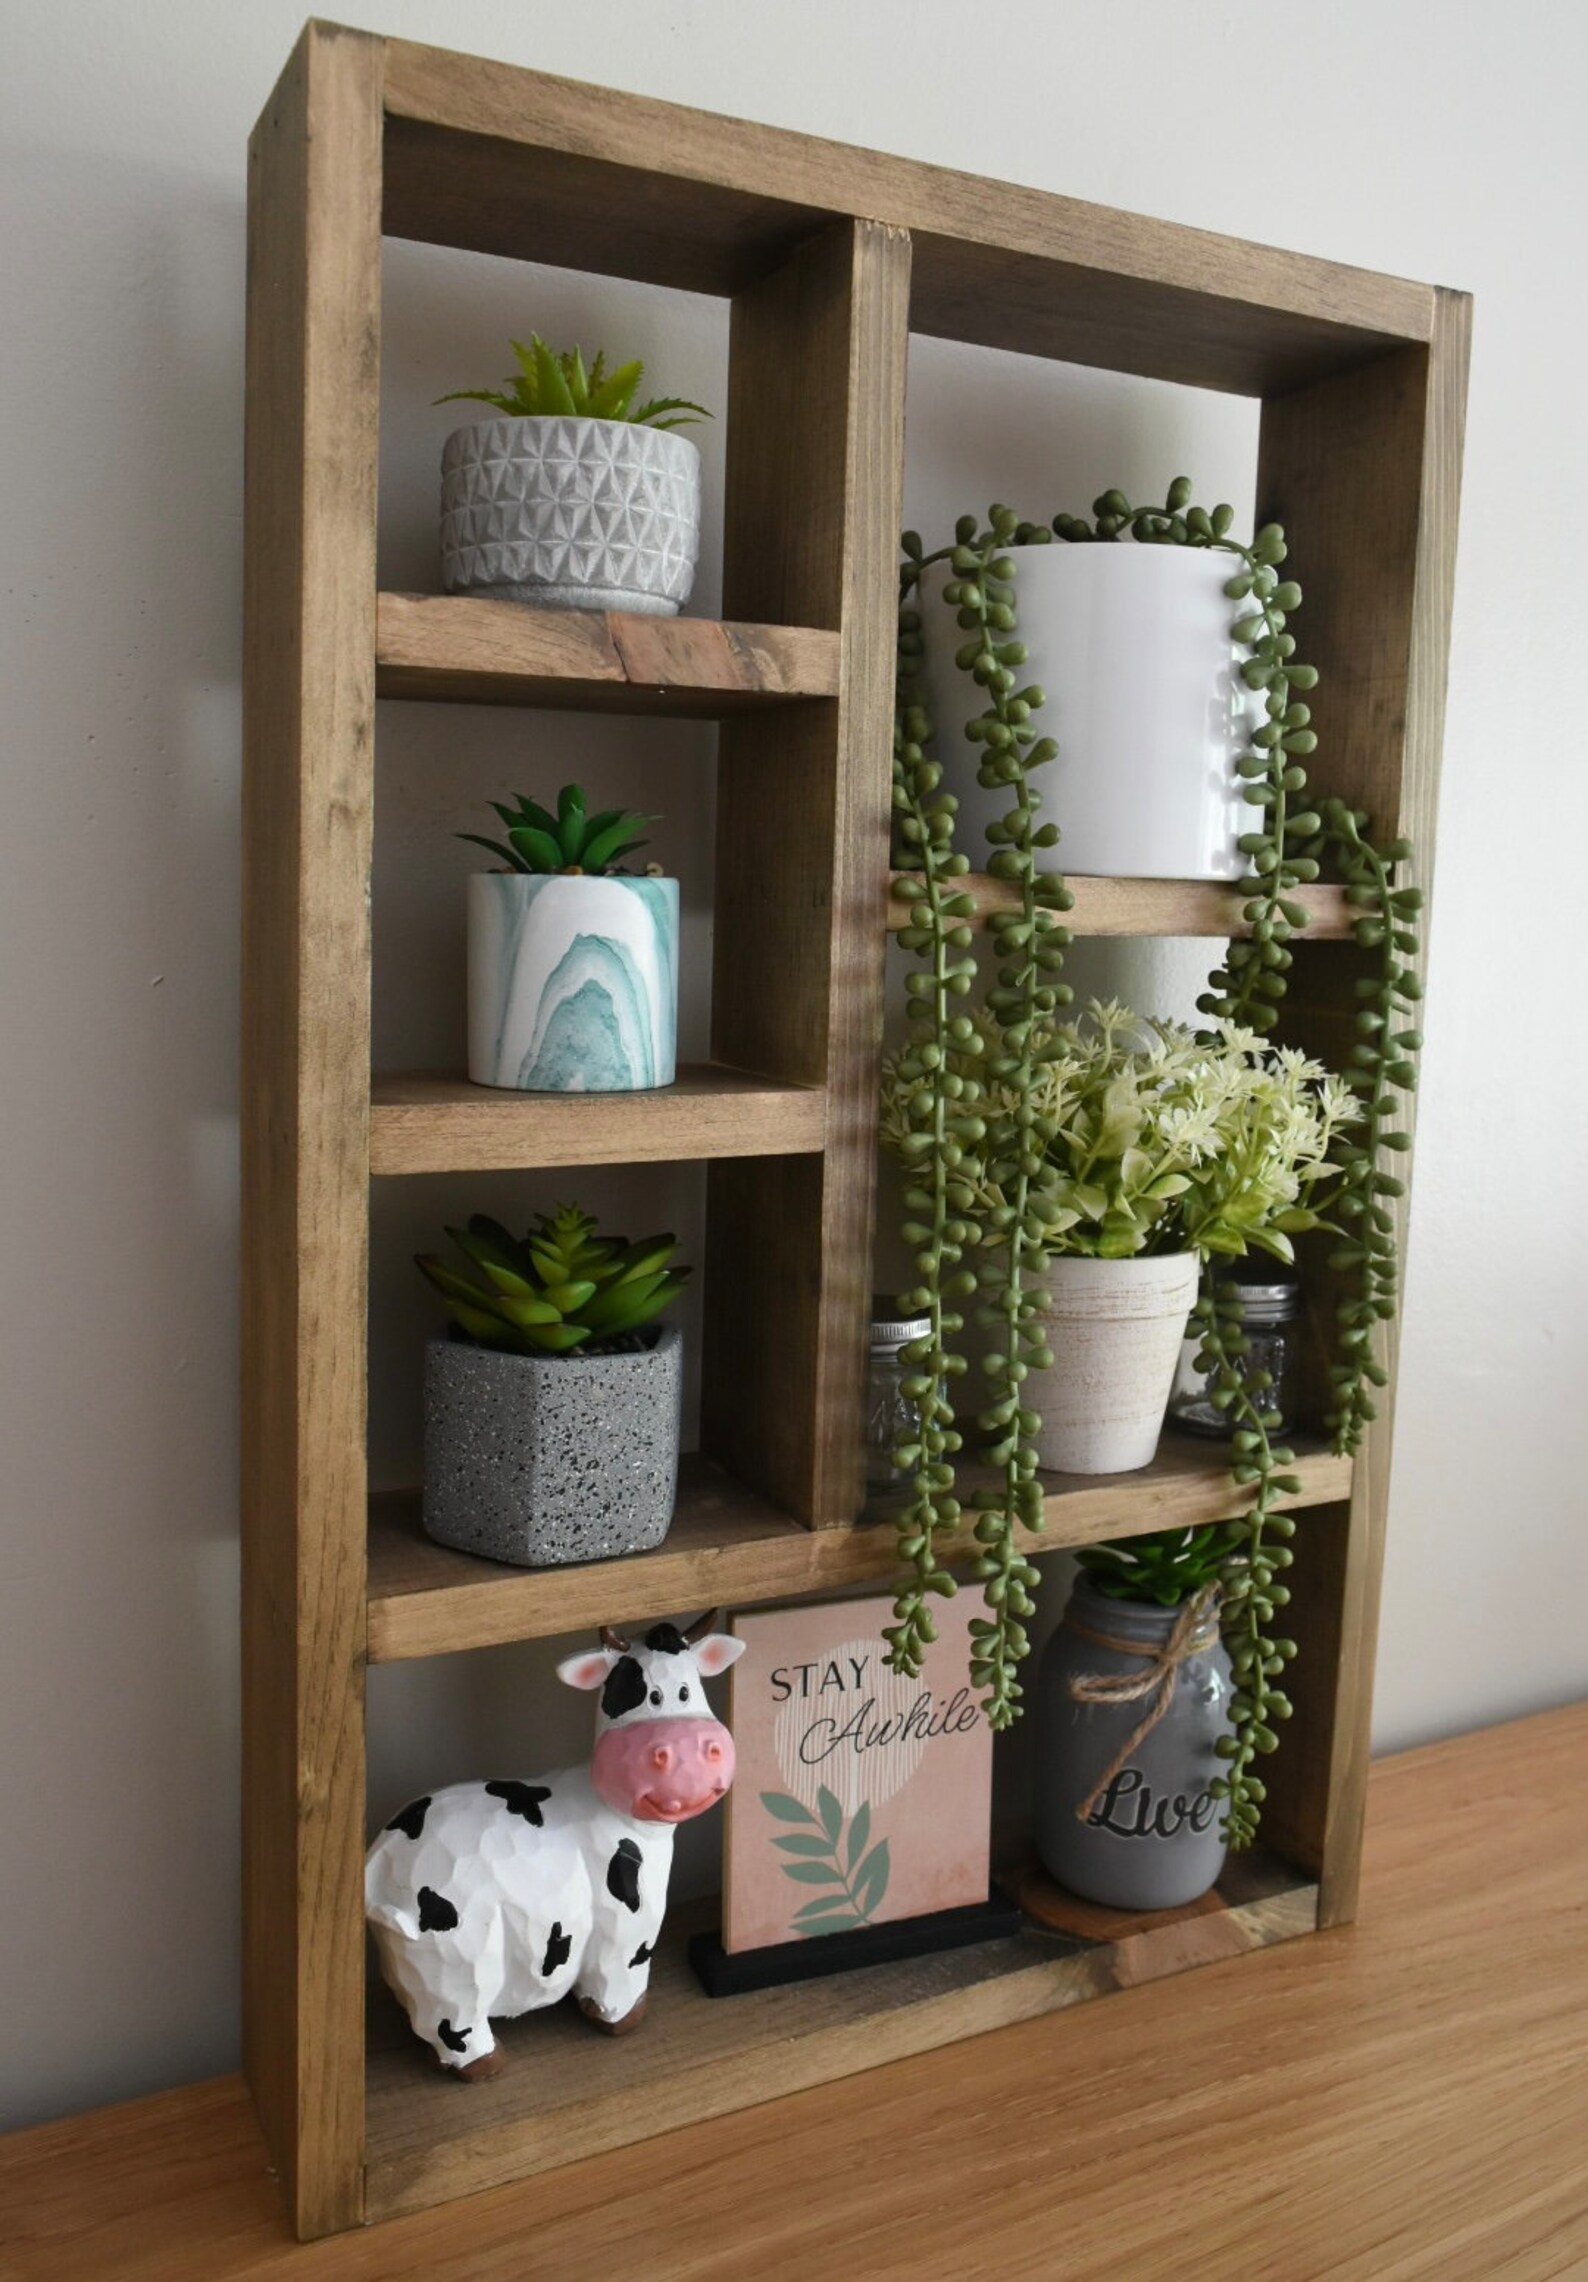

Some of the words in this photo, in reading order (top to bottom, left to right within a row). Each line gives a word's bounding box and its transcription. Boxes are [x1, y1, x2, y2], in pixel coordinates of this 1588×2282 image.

[770, 1655, 870, 1702] STAY
[799, 1687, 980, 1765] Awhile
[1087, 1768, 1217, 1838] Live
